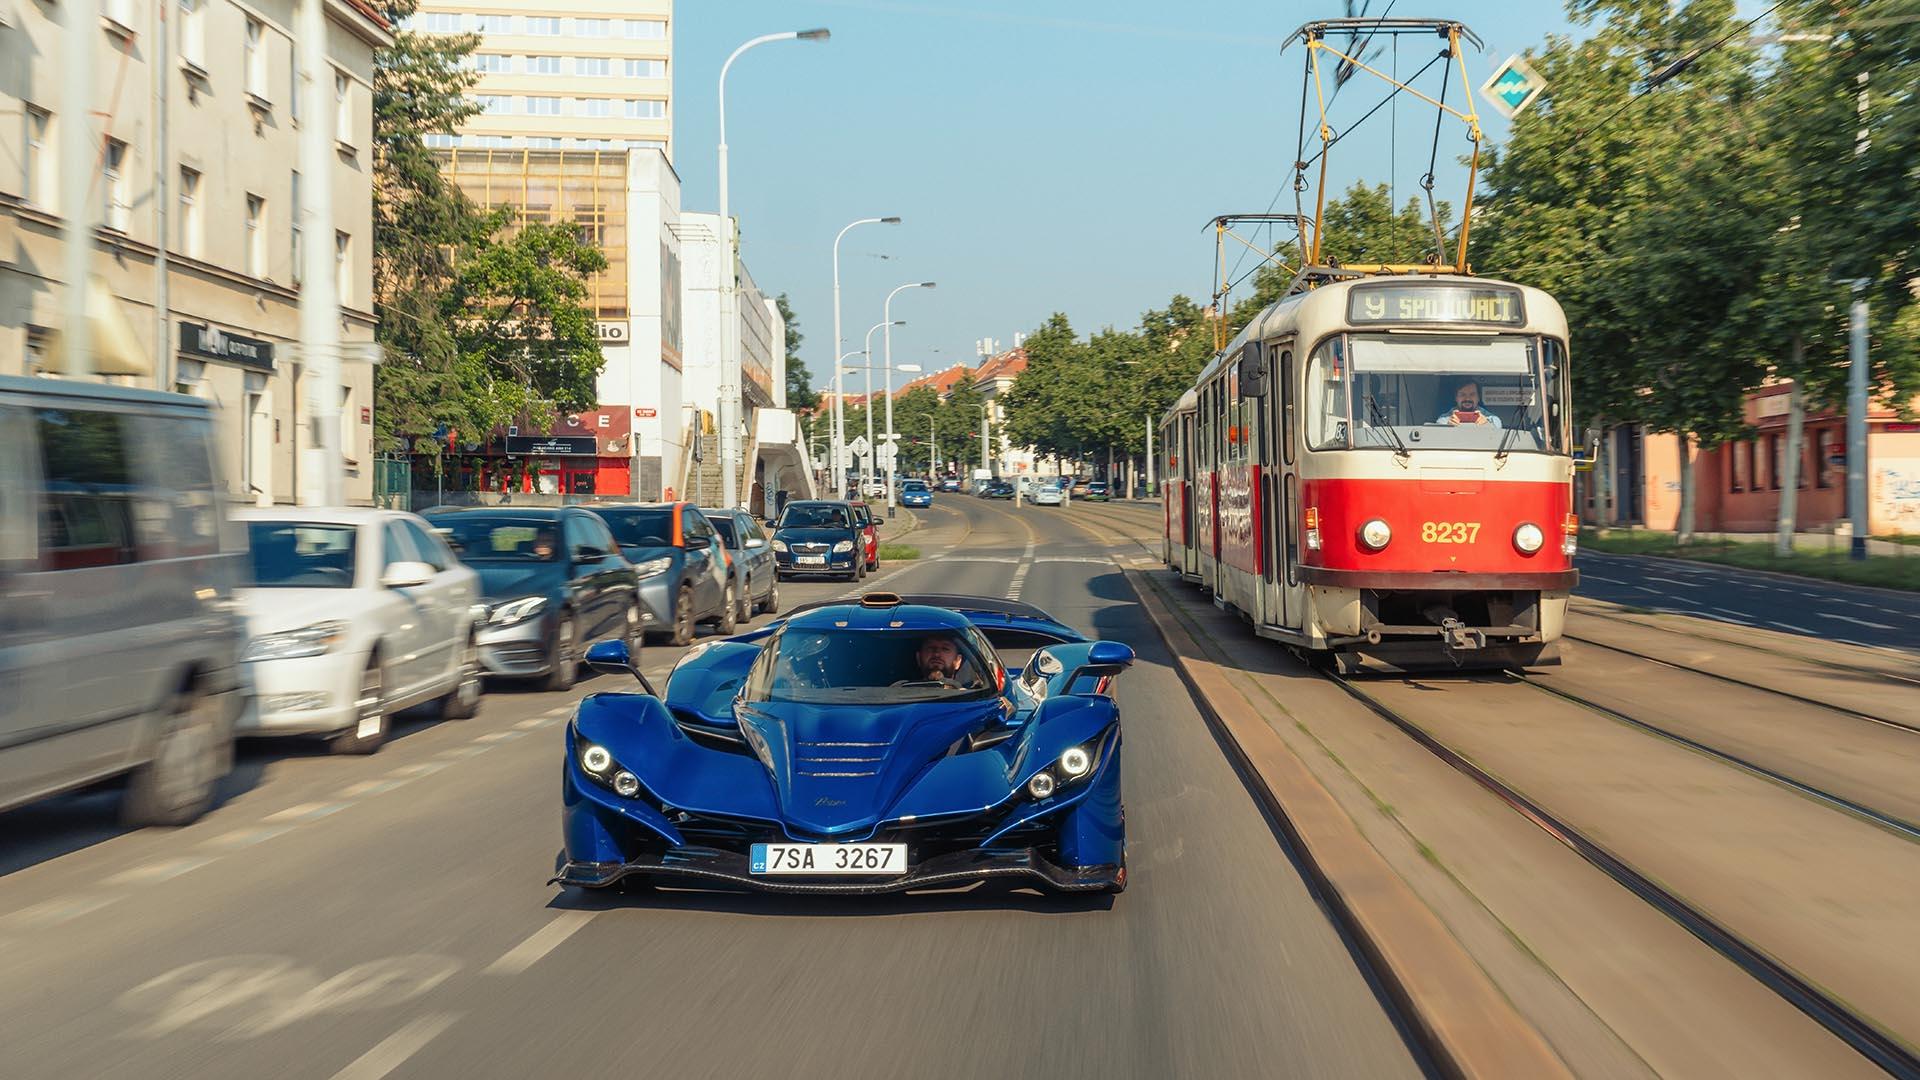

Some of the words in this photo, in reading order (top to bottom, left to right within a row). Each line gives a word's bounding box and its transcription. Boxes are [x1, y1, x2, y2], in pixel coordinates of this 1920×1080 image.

[1422, 521, 1481, 544] 8237
[753, 862, 765, 870] CZ
[772, 848, 815, 869] 7SA
[835, 848, 894, 869] 3267
